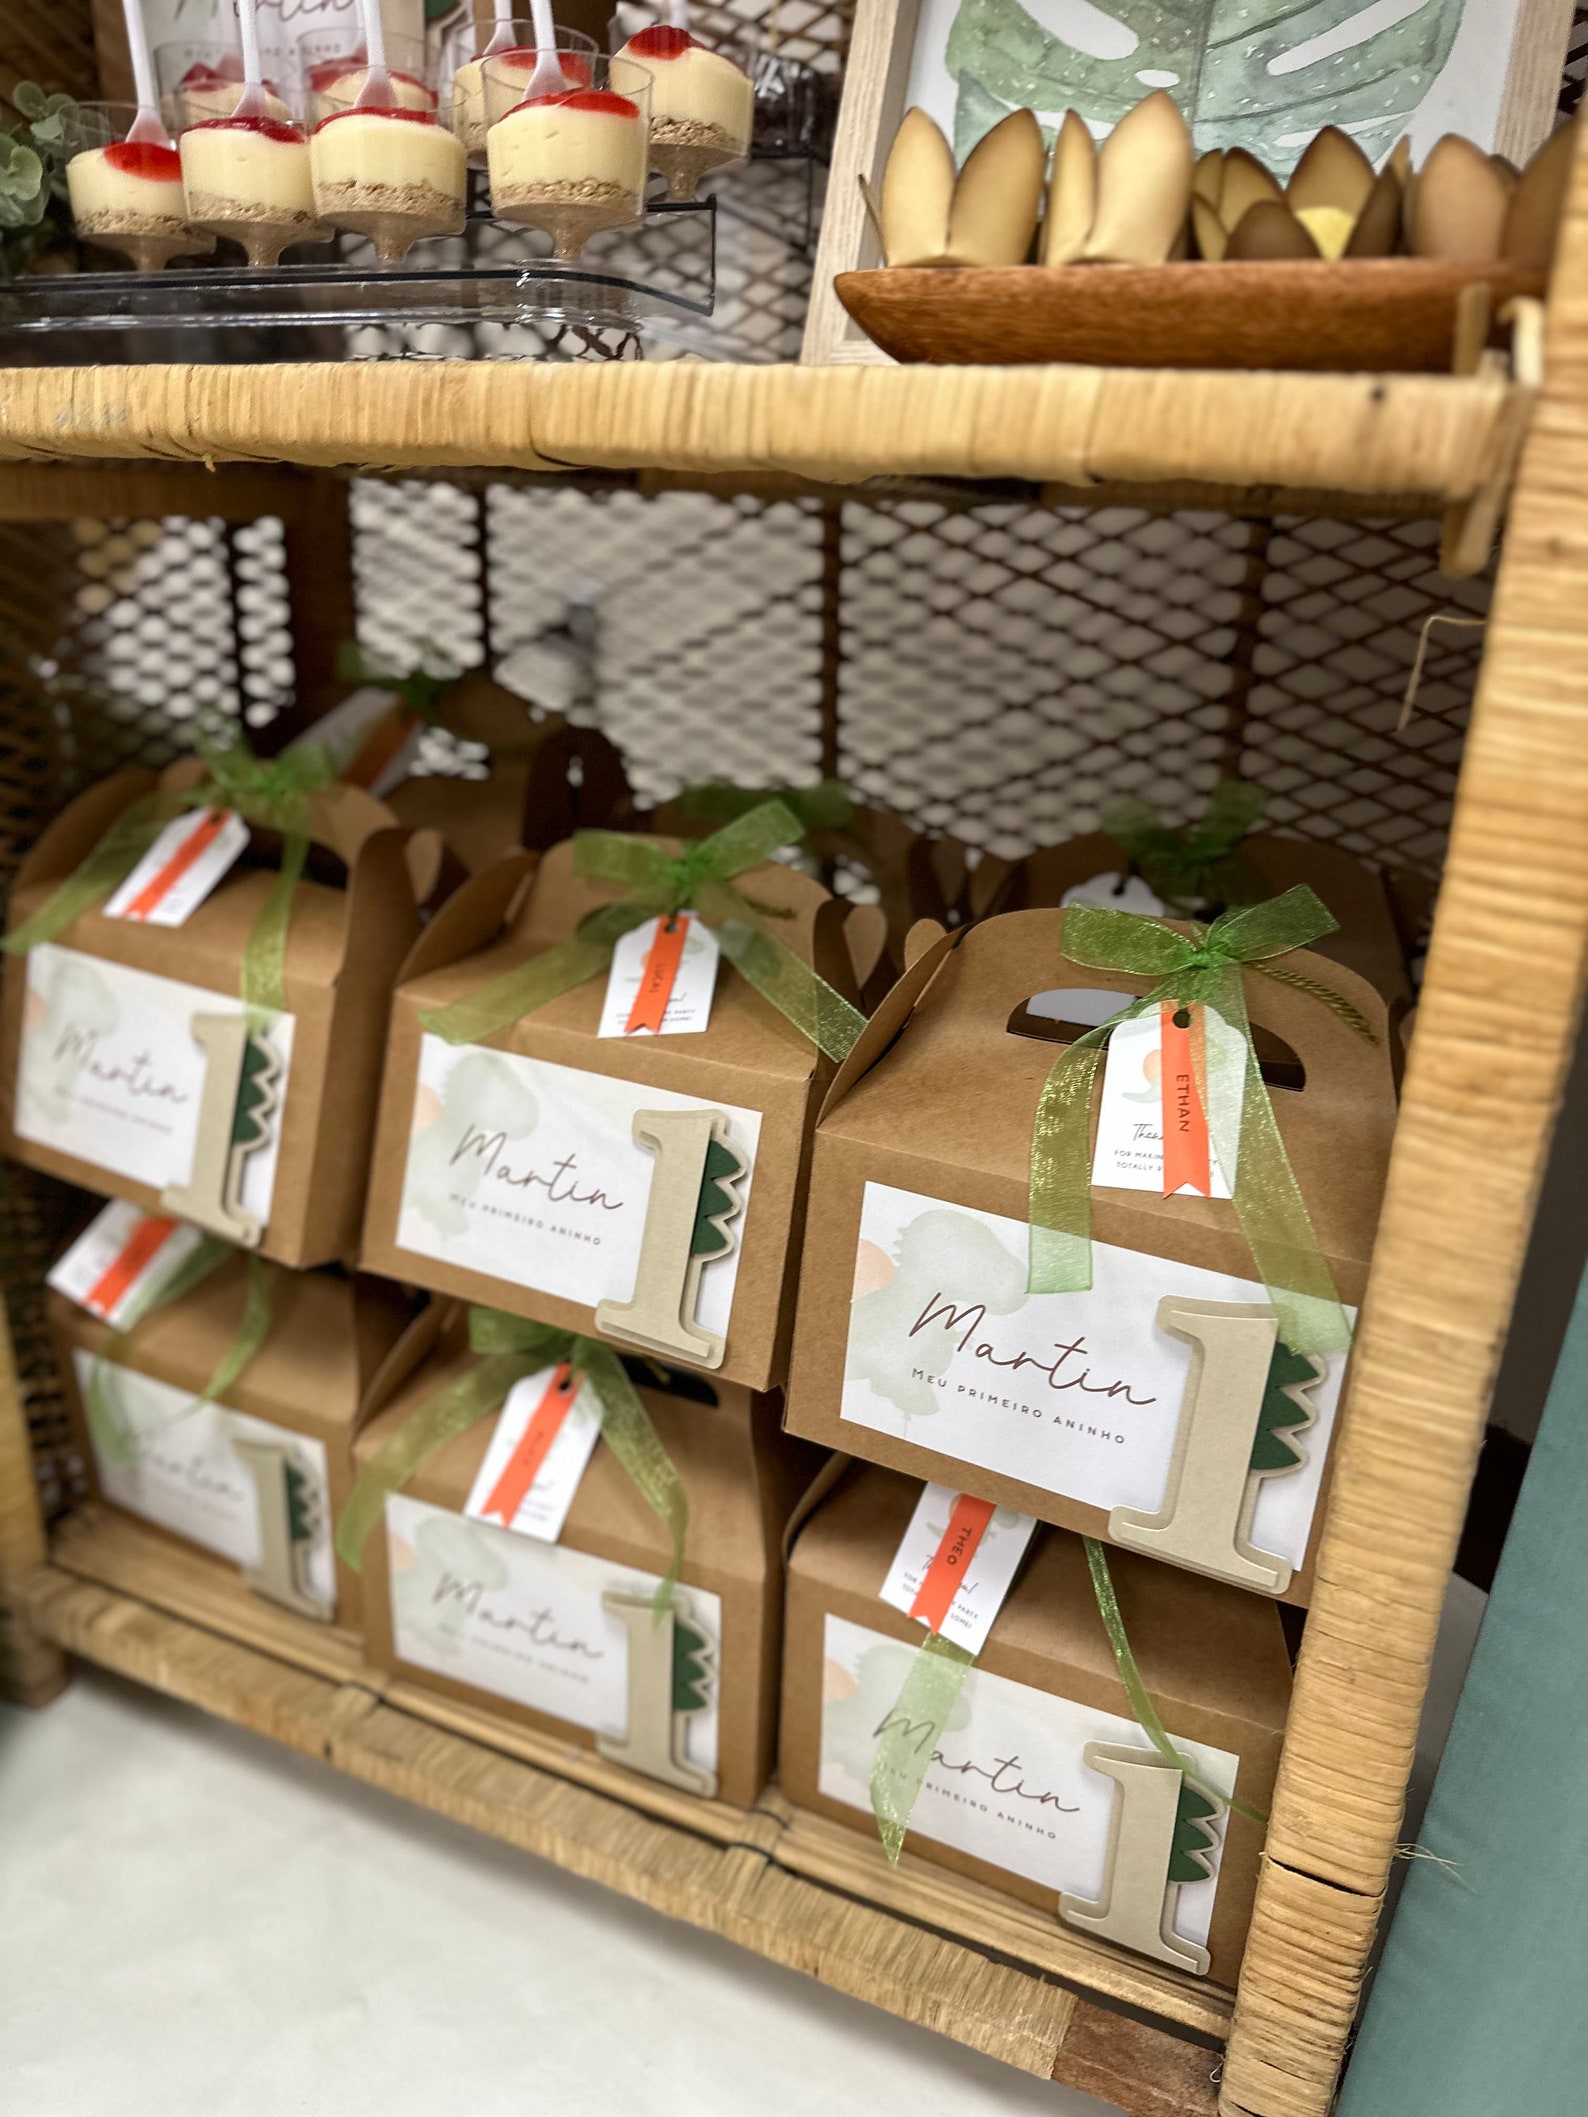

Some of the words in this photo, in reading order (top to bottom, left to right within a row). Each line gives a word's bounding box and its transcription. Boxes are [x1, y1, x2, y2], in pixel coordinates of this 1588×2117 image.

[1175, 1073, 1191, 1133] ETHAN
[449, 1124, 624, 1210] Martin
[450, 1192, 477, 1210] MEU
[481, 1204, 545, 1230] PRIMEIRO
[550, 1225, 602, 1246] ANINHO
[908, 1291, 1157, 1406] Martin
[911, 1367, 948, 1389] MEU
[957, 1384, 1043, 1419] PRIMEIRO
[1052, 1415, 1126, 1445] ANINHO
[946, 1526, 974, 1566] THEO
[430, 1572, 604, 1660] Martin
[872, 1708, 1081, 1814] Martin
[996, 1811, 1058, 1841] ANINHO
